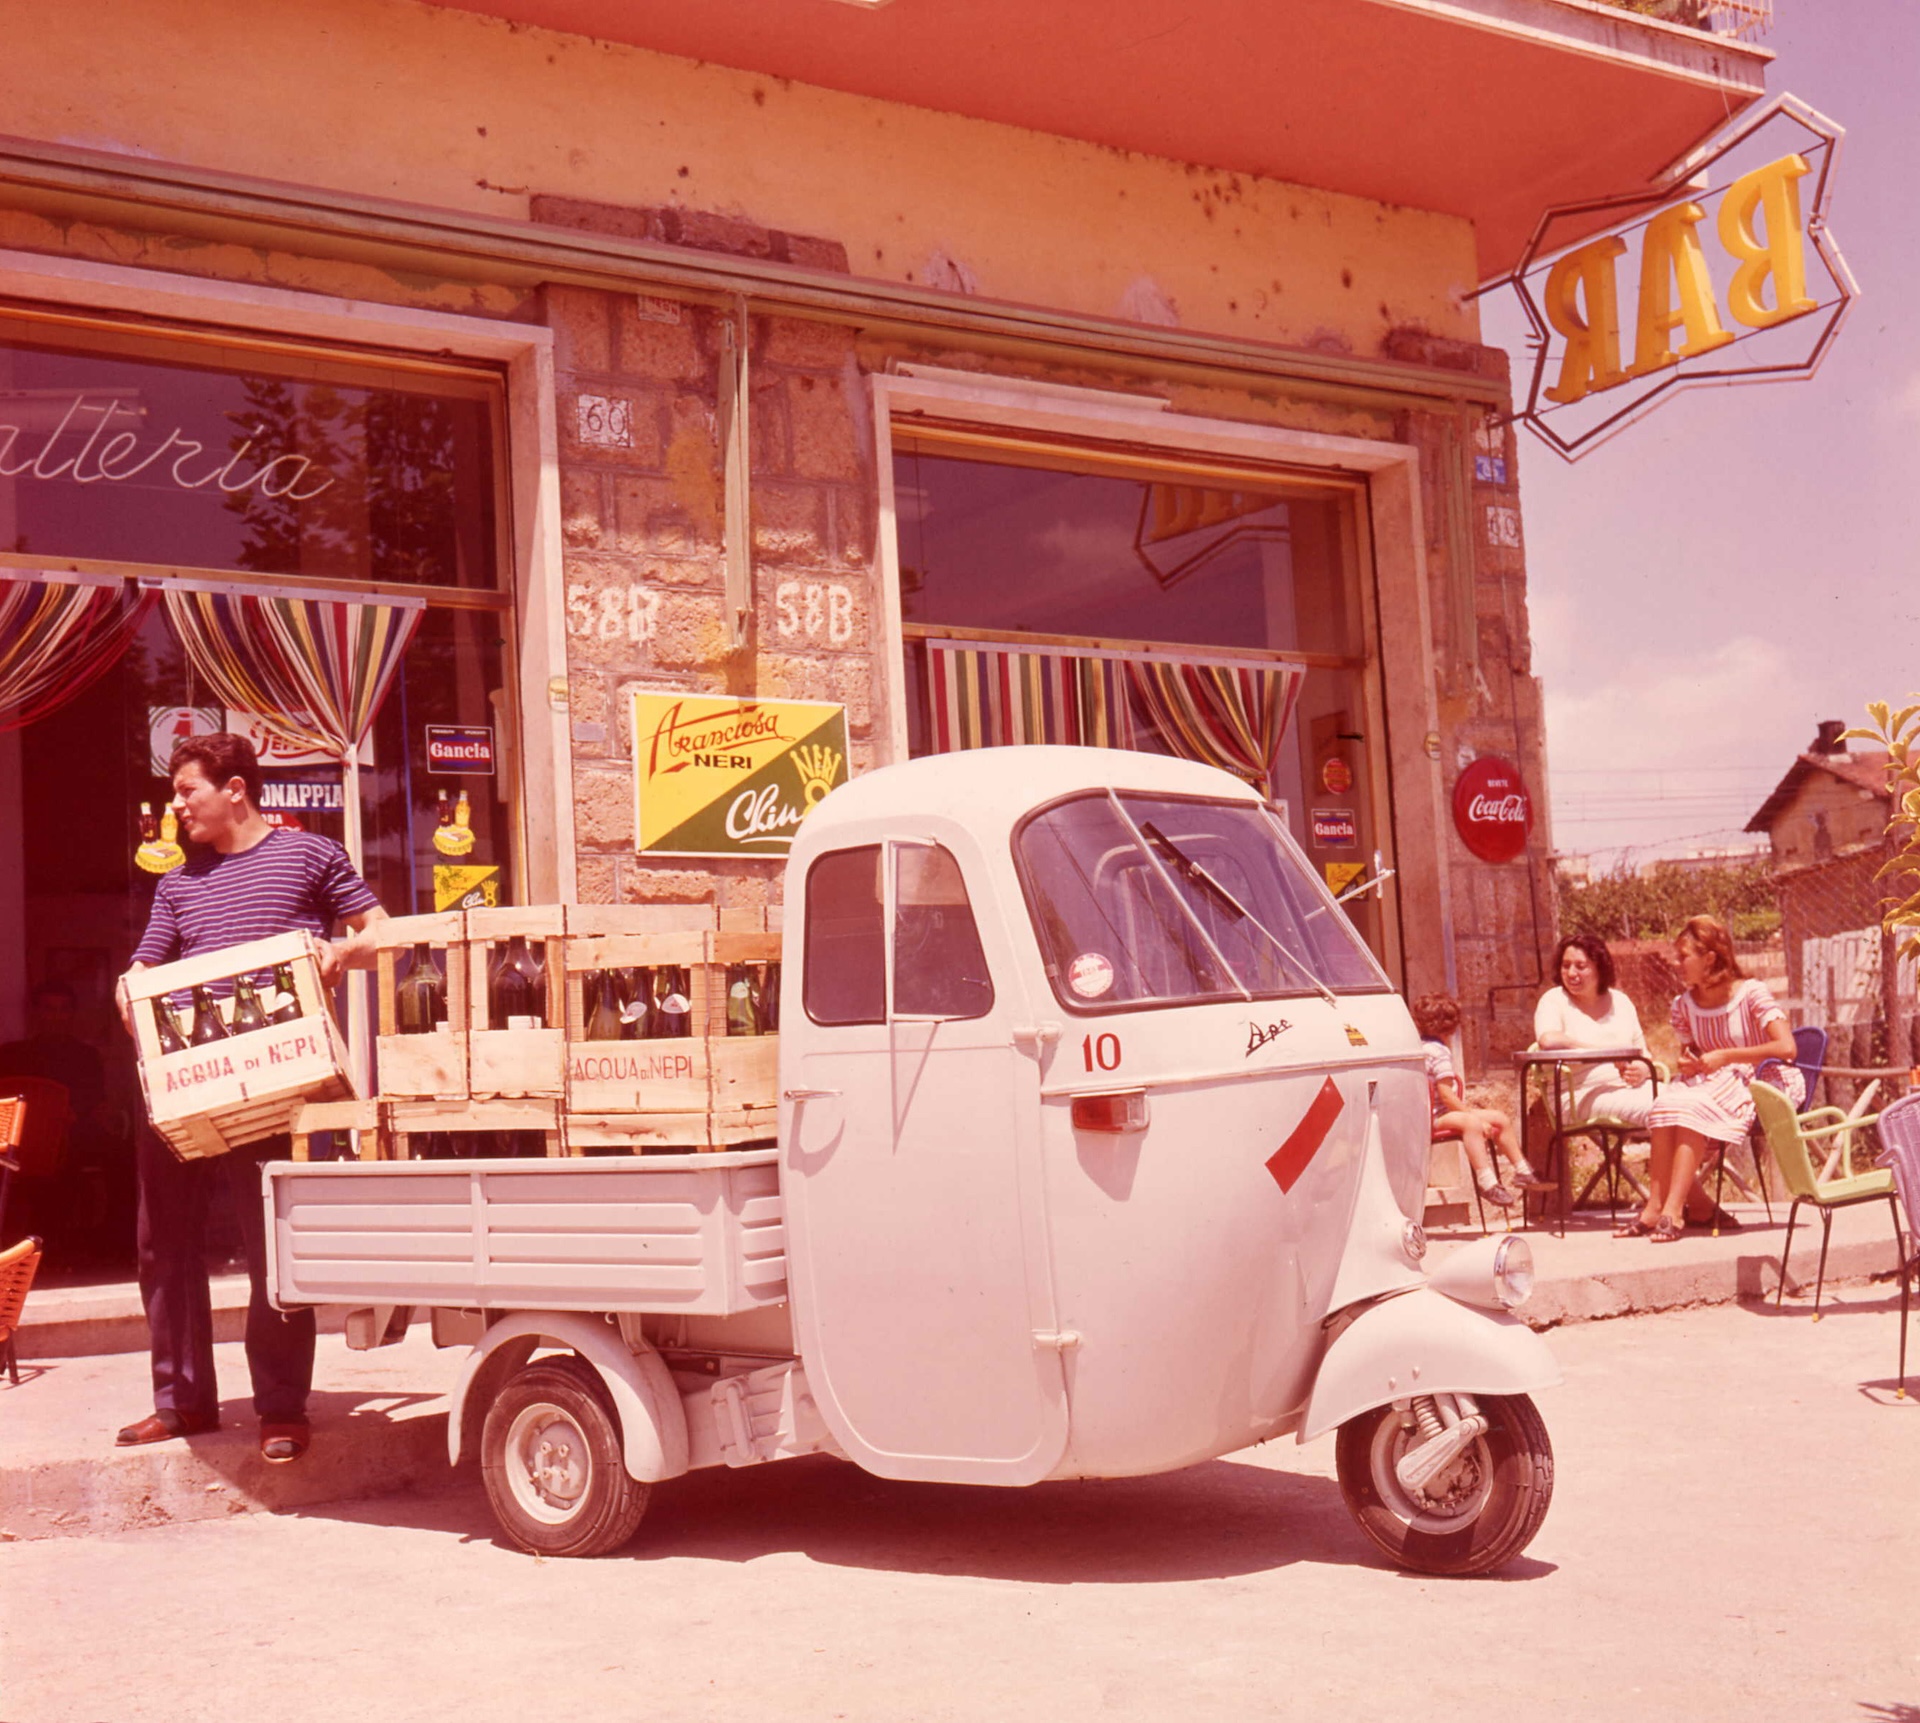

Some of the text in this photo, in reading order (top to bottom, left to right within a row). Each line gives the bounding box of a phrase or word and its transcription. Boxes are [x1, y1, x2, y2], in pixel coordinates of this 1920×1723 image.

[430, 742, 490, 759] Gancia
[643, 701, 794, 781] Aranciosa
[693, 753, 753, 770] NERI
[1314, 822, 1354, 836] Gancia
[1245, 1018, 1293, 1058] Ape
[1082, 1032, 1122, 1073] 10
[574, 1057, 639, 1081] ACQUA
[648, 1055, 693, 1079] NEPI
